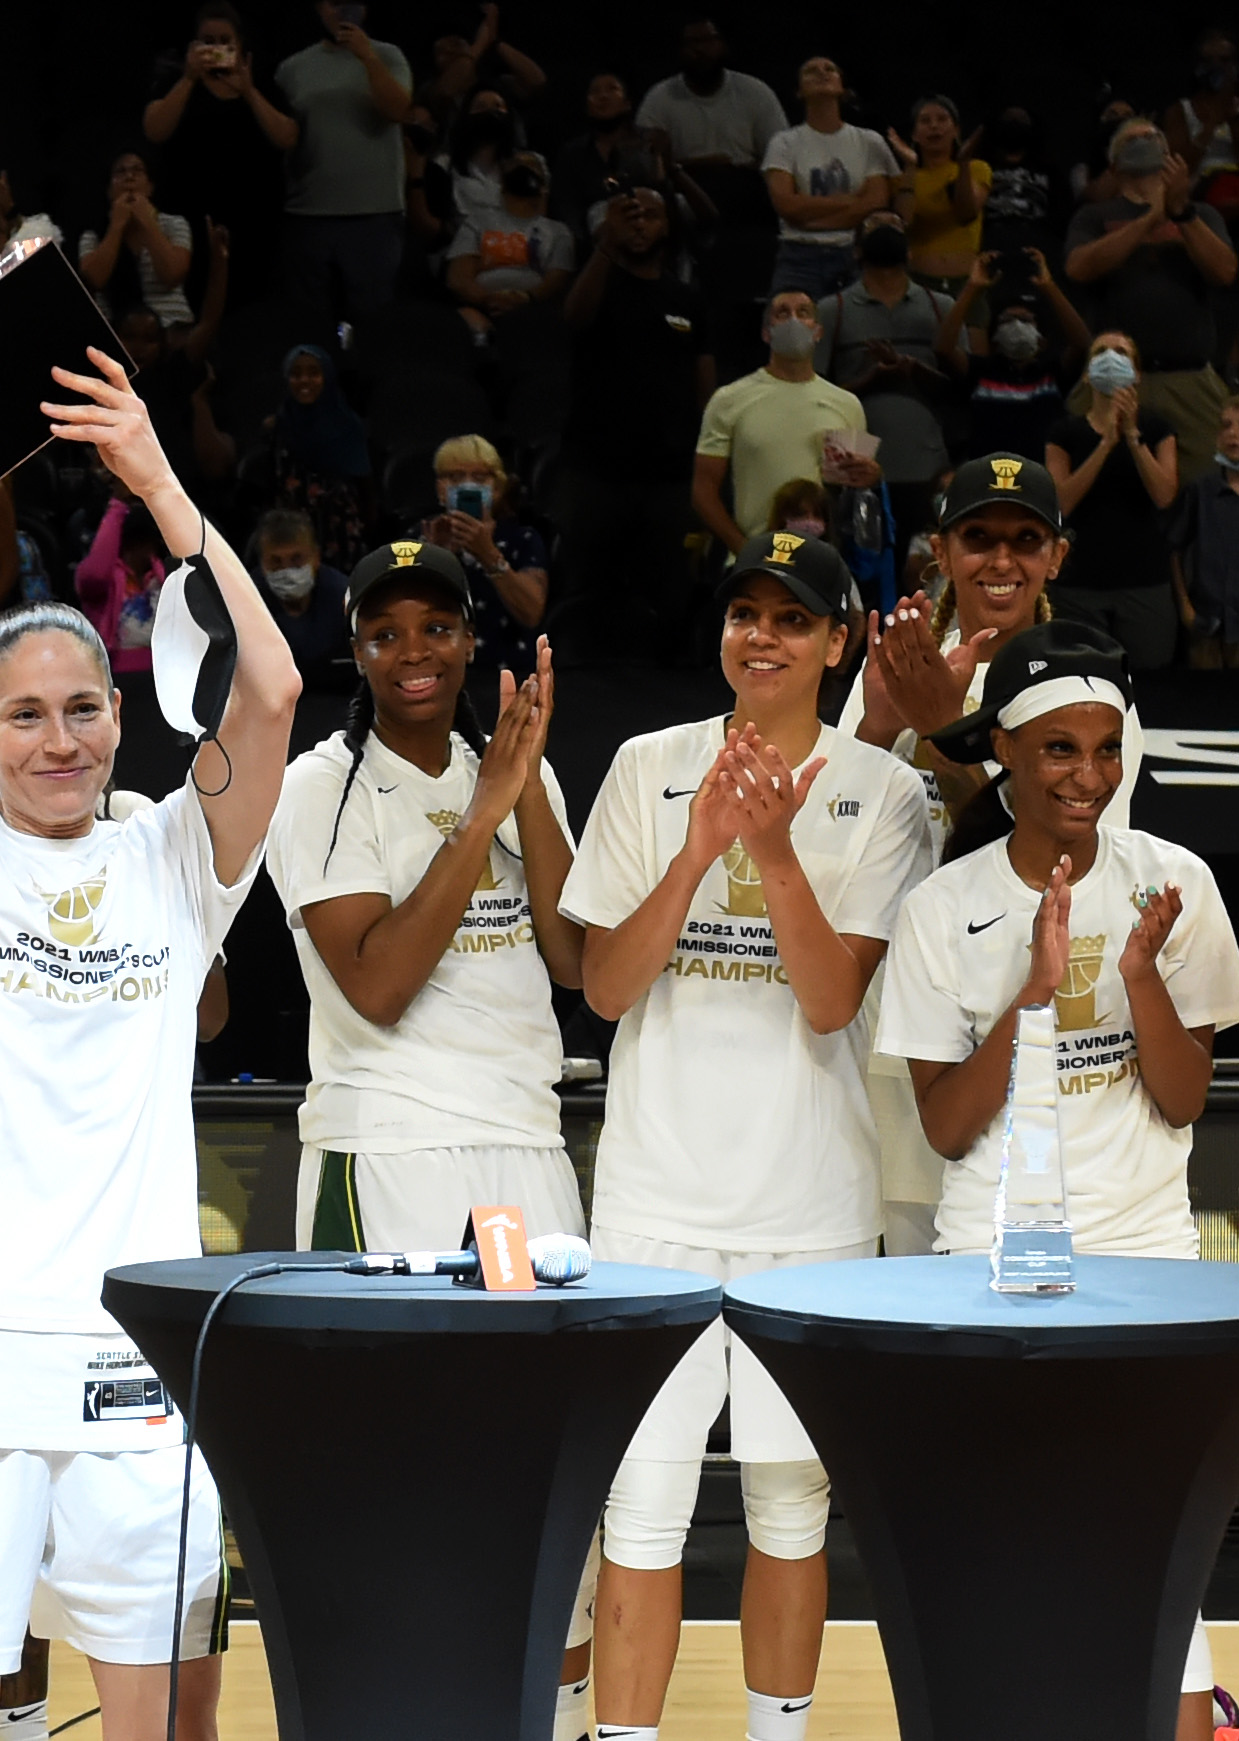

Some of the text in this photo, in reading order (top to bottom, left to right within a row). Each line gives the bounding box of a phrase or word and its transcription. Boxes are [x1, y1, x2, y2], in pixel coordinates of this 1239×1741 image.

[687, 921, 774, 940] 2021 WN
[16, 932, 72, 962] 2021
[1074, 1030, 1135, 1051] WNBA
